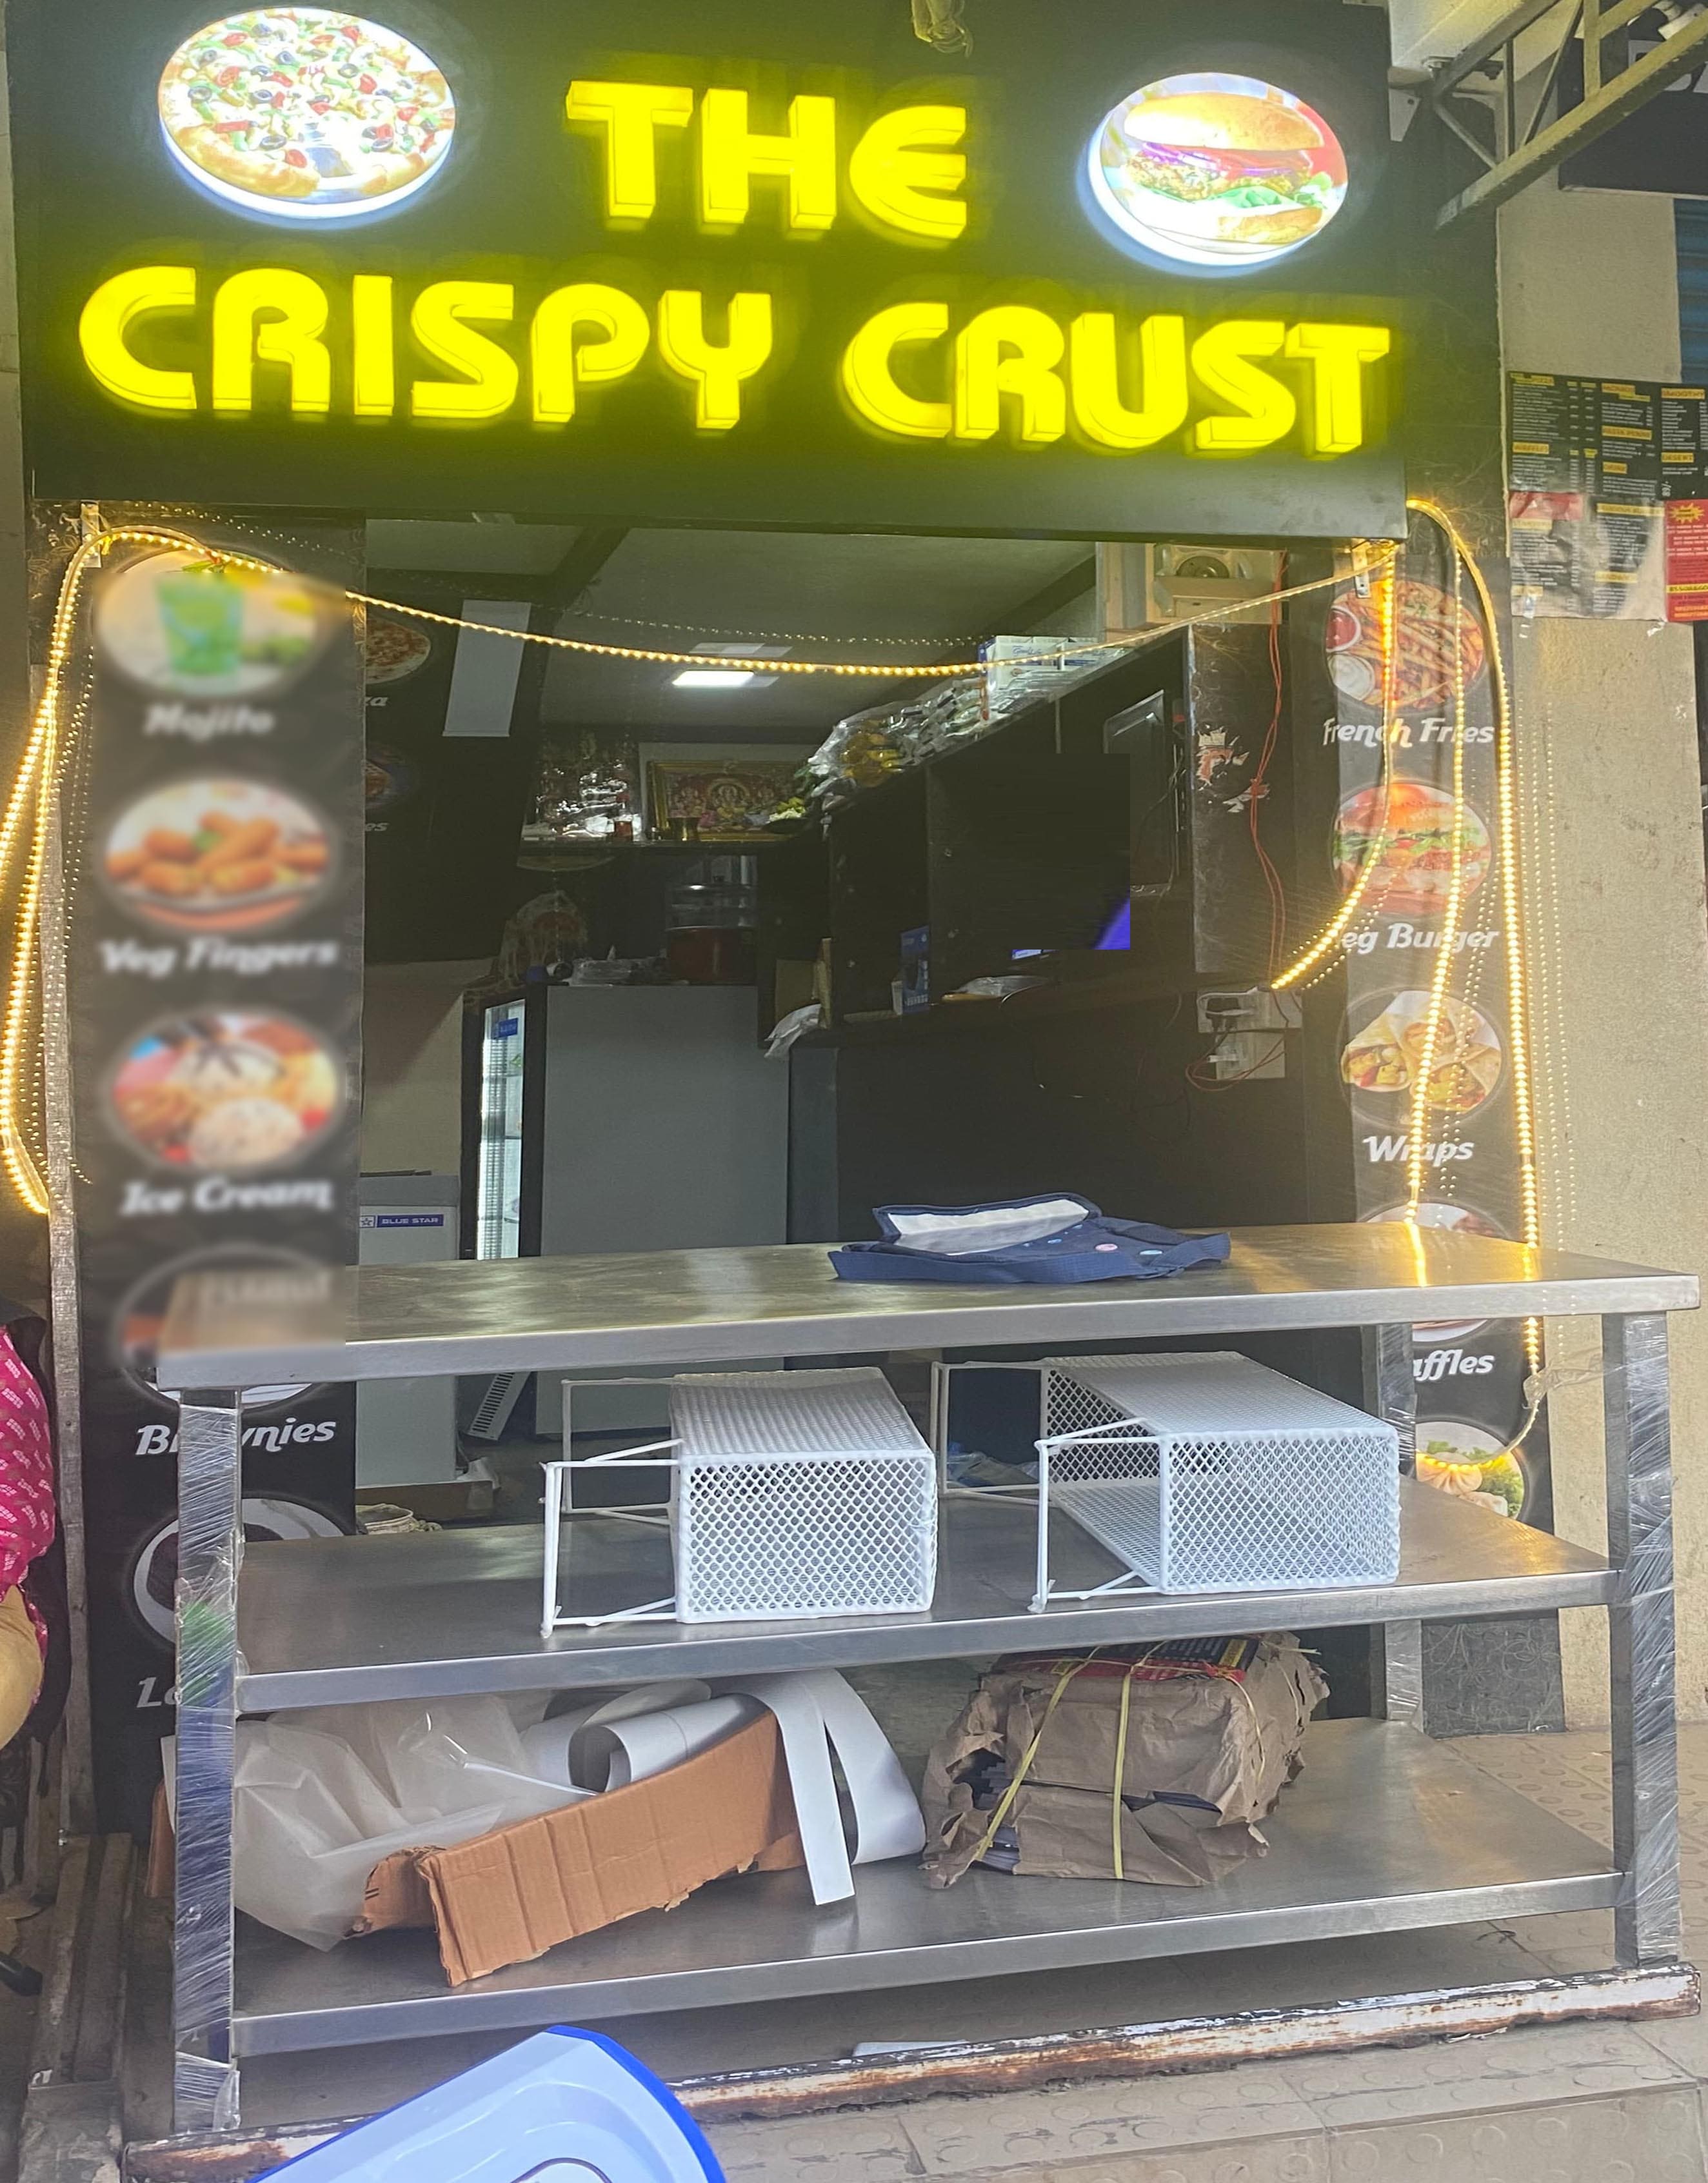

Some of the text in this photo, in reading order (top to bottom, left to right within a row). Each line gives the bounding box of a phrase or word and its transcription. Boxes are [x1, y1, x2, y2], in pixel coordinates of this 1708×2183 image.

[565, 80, 967, 239] THE
[79, 265, 1390, 454] CRISPY CRUST
[1341, 931, 1378, 954] eg
[1362, 1135, 1475, 1166] Wraps
[1413, 1349, 1494, 1381] ffles
[135, 1417, 336, 1455] Bnies
